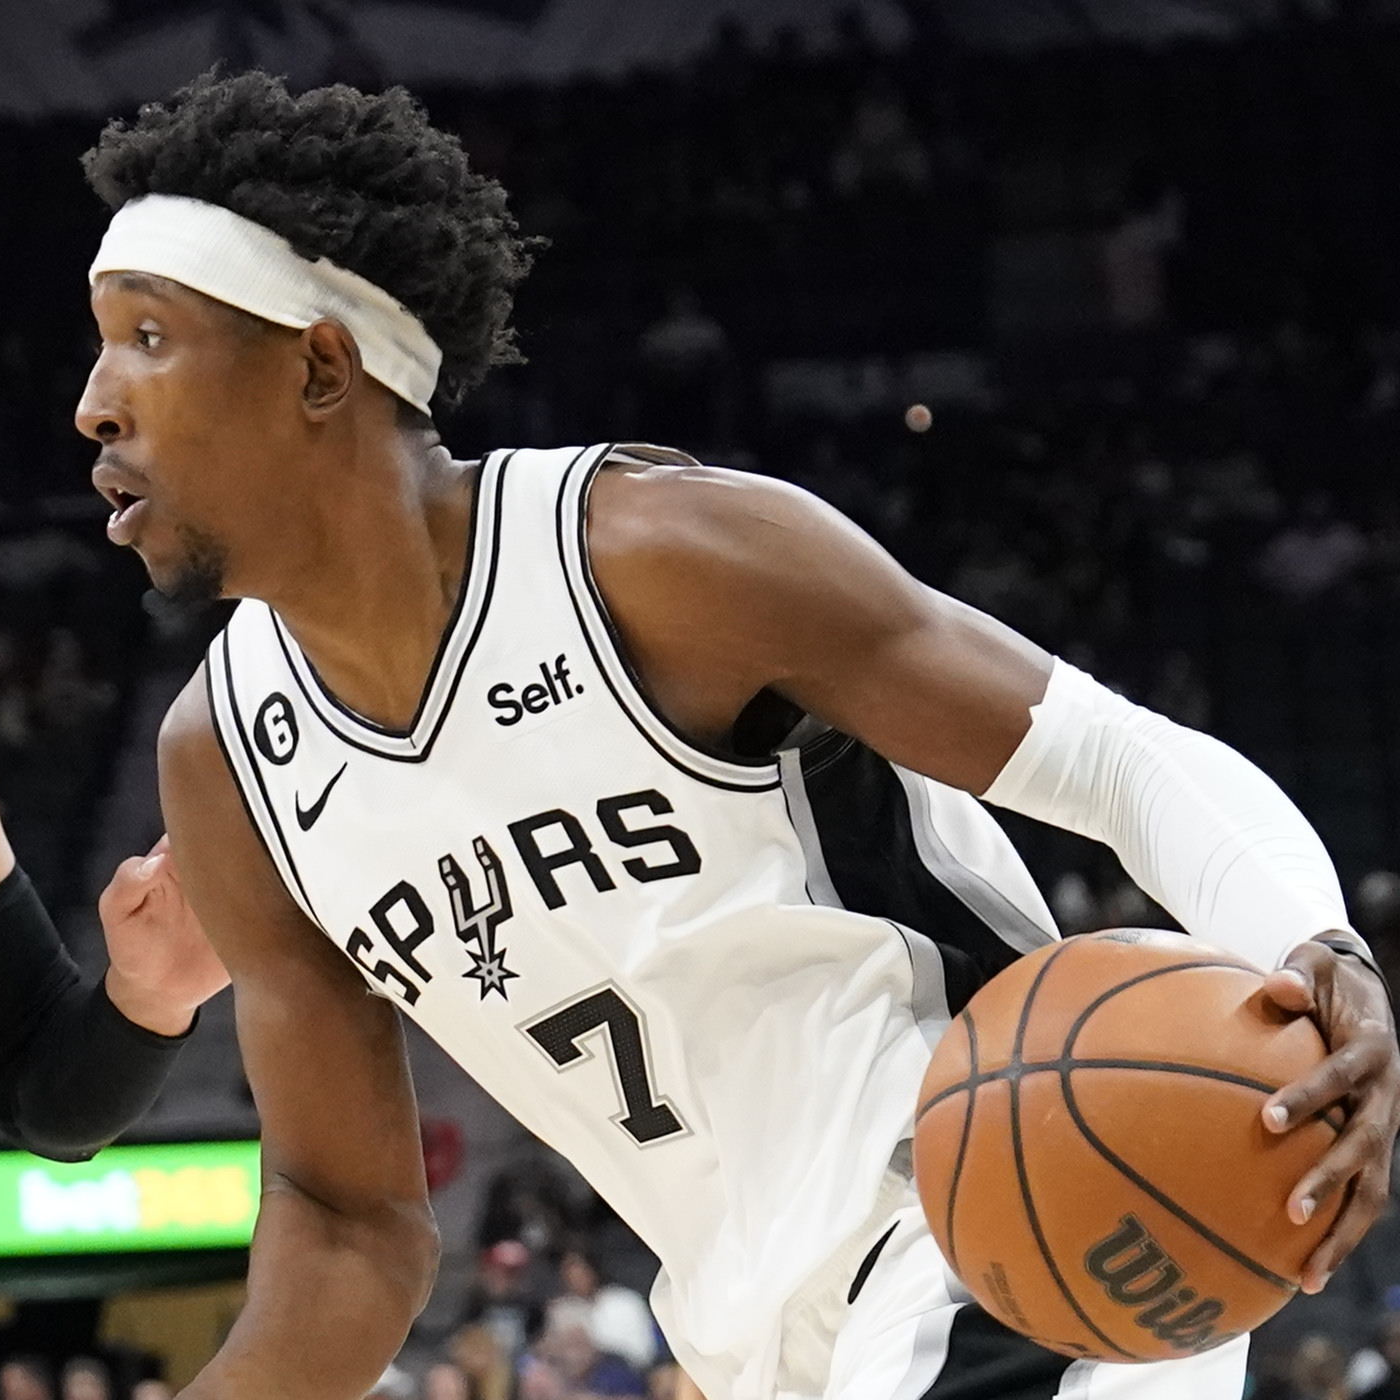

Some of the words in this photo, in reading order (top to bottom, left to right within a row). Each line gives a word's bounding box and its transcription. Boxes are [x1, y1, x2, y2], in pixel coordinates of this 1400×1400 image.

[262, 700, 295, 759] 6
[487, 653, 584, 726] Self.
[346, 788, 702, 1006] SPURS
[515, 978, 695, 1150] 7
